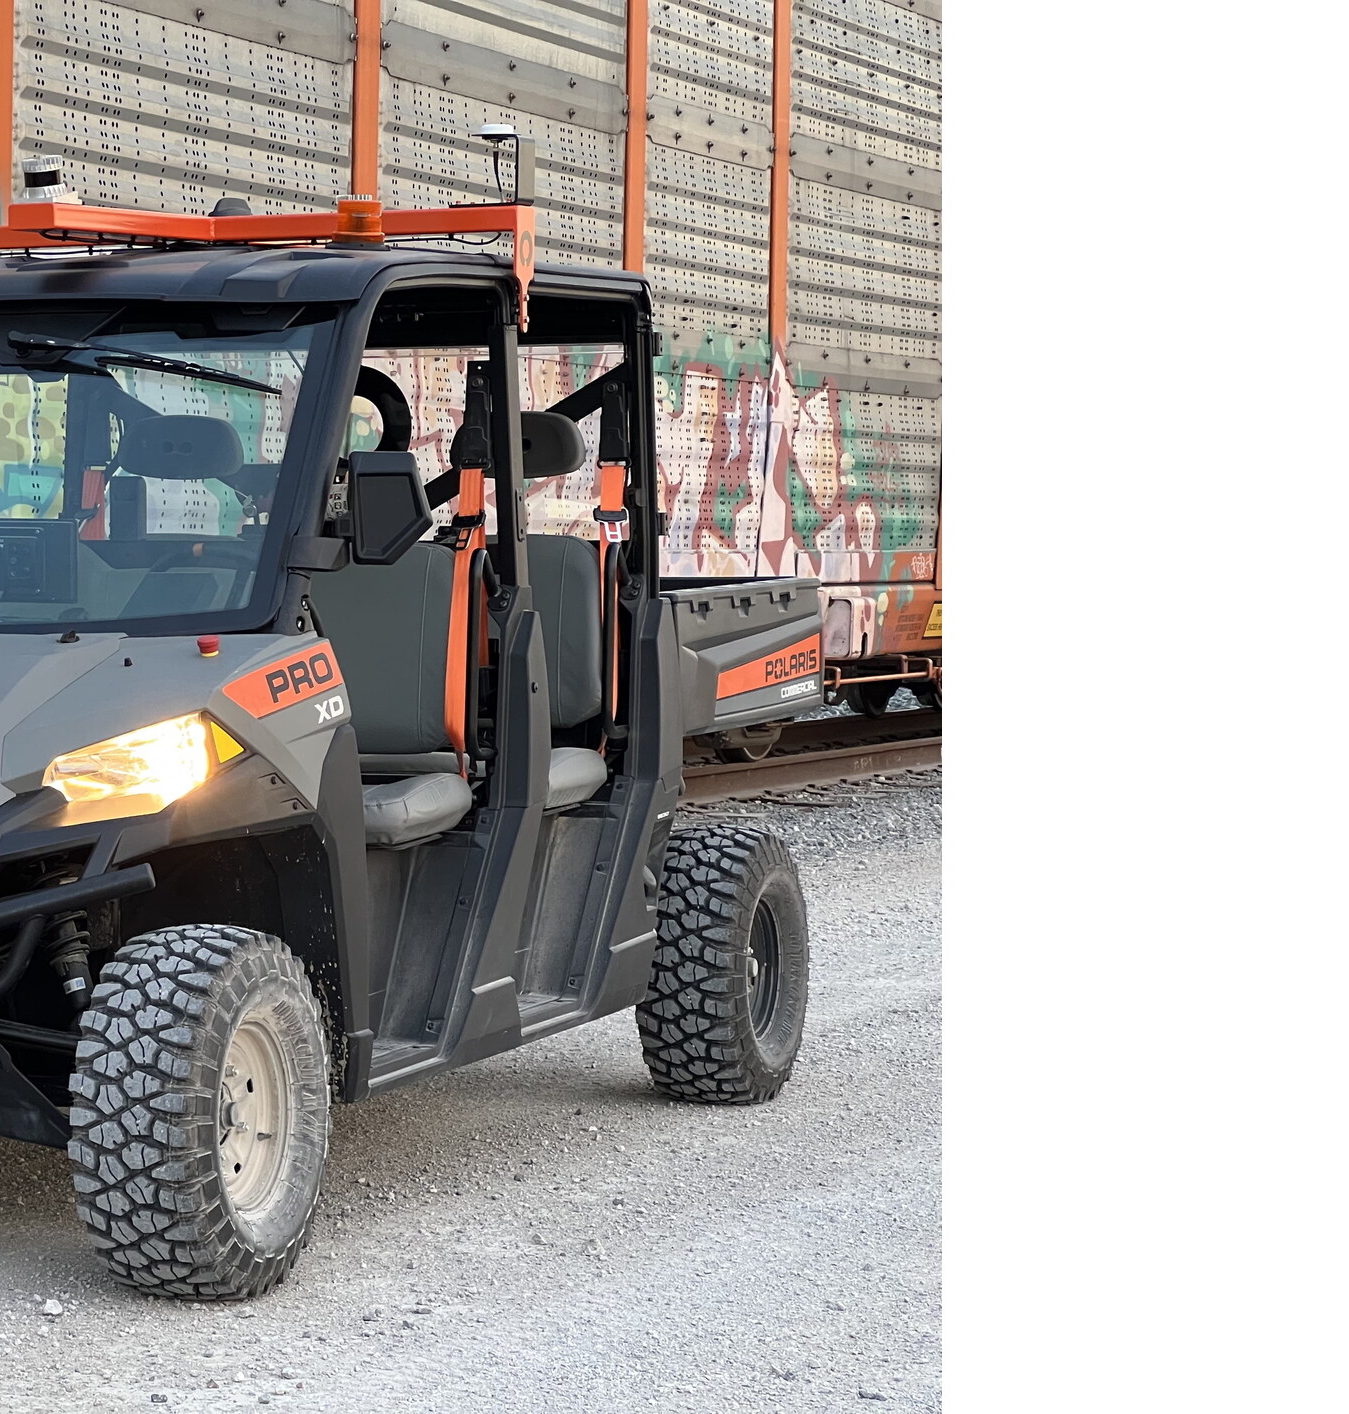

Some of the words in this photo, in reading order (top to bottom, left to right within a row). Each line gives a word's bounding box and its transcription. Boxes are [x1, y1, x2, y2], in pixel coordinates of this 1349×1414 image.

[265, 652, 334, 704] PRO
[765, 648, 817, 683] POLARIS
[314, 695, 345, 724] XD
